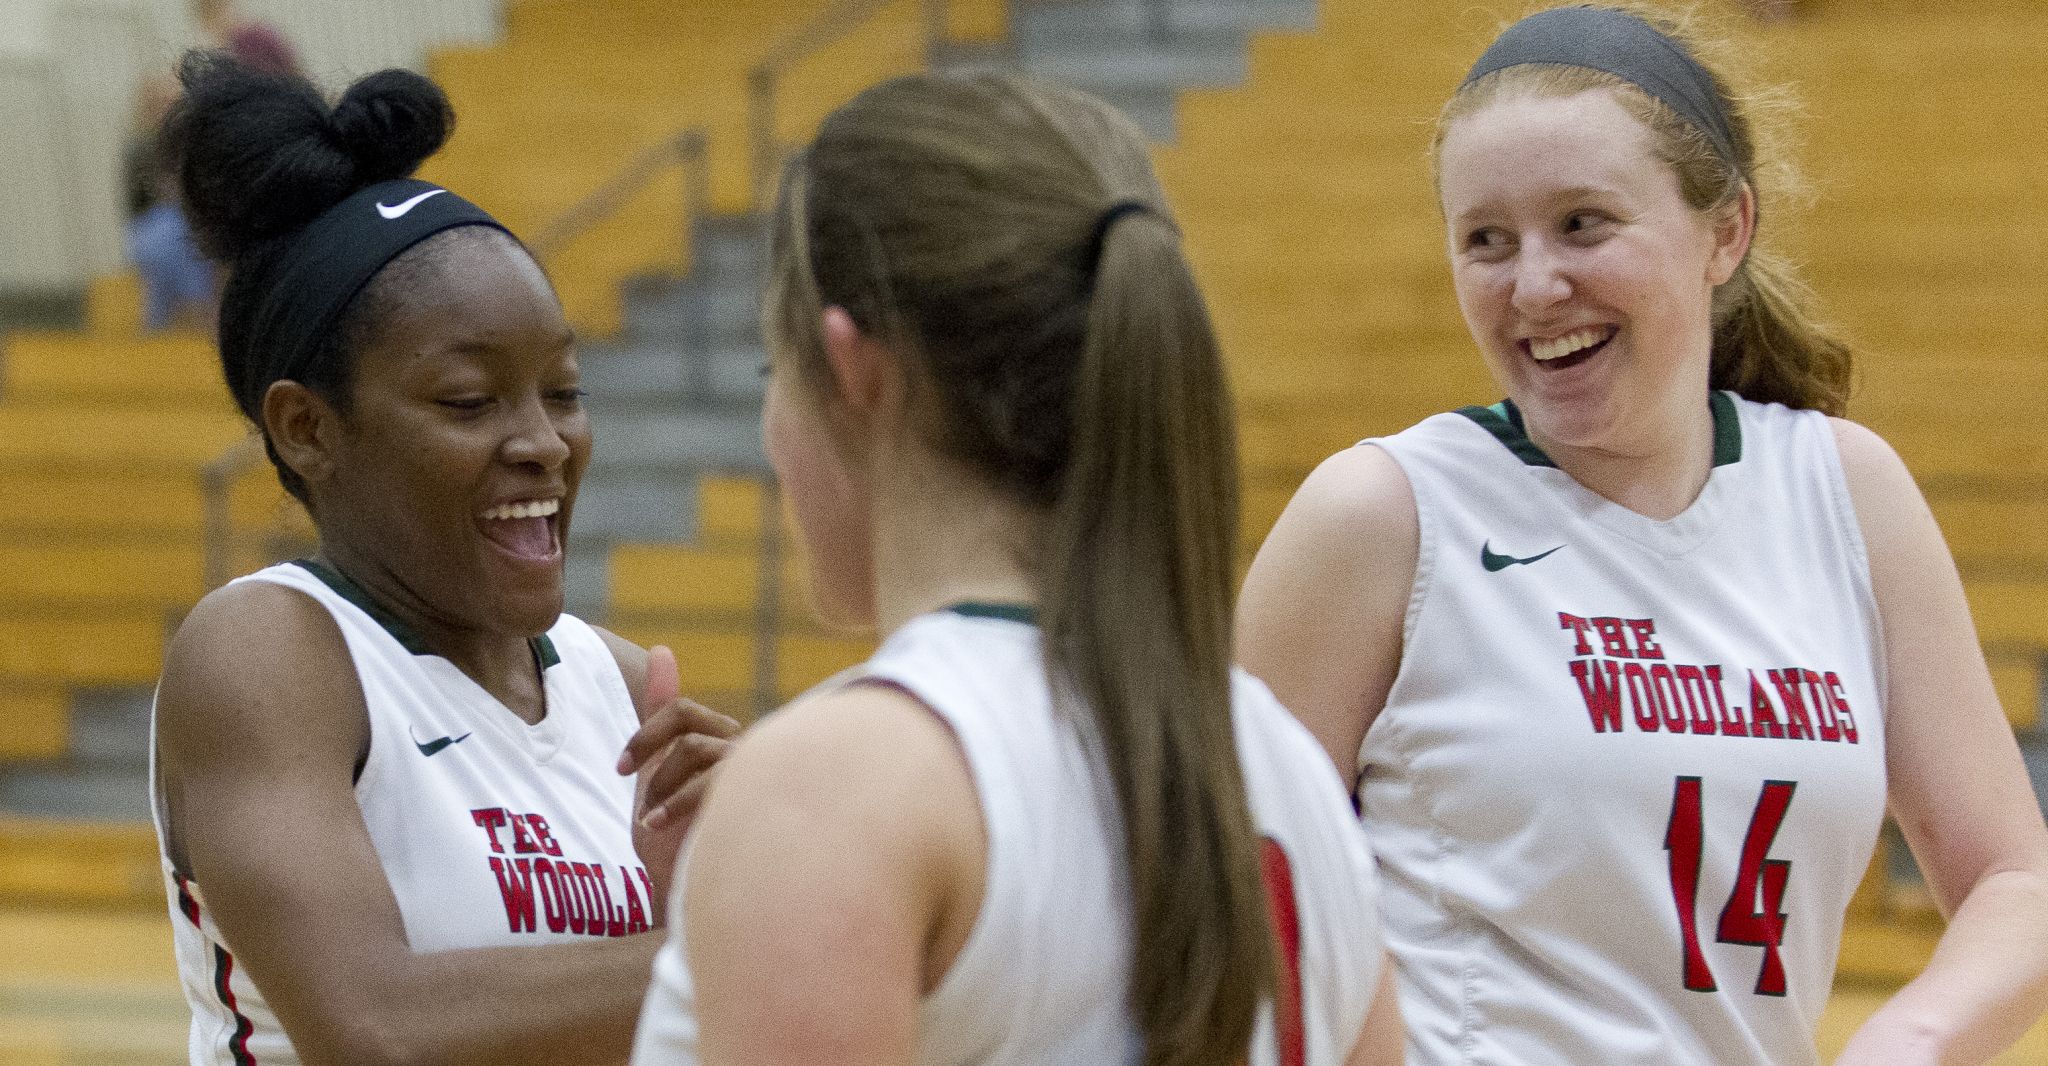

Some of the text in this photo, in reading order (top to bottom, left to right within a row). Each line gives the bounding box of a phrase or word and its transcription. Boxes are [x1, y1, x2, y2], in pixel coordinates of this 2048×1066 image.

[1558, 612, 1665, 660] THE
[1568, 660, 1858, 744] WOODLANDS
[1664, 775, 1798, 997] 14
